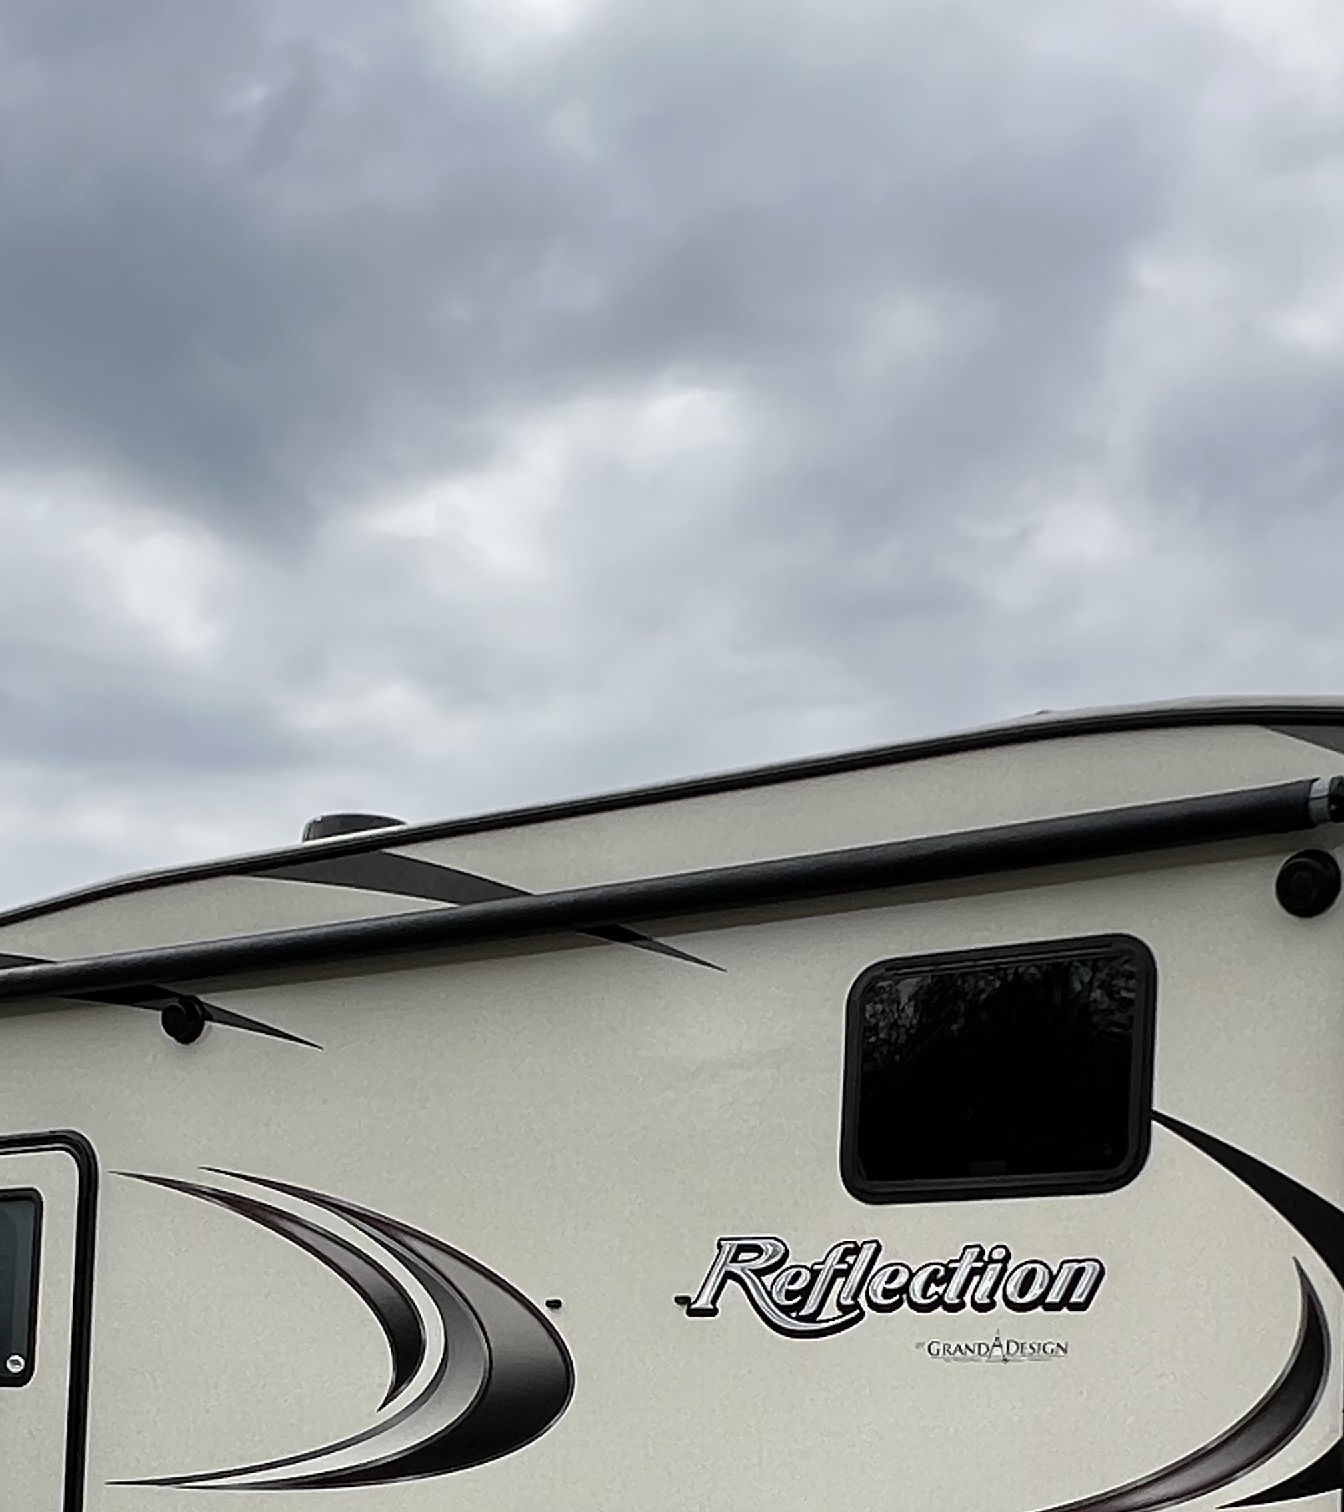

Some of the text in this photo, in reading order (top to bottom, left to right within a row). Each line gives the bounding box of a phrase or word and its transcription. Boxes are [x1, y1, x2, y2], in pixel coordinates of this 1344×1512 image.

[685, 1236, 1106, 1339] Reflection
[927, 1340, 990, 1357] GRAND
[1006, 1339, 1069, 1356] DESIGN
